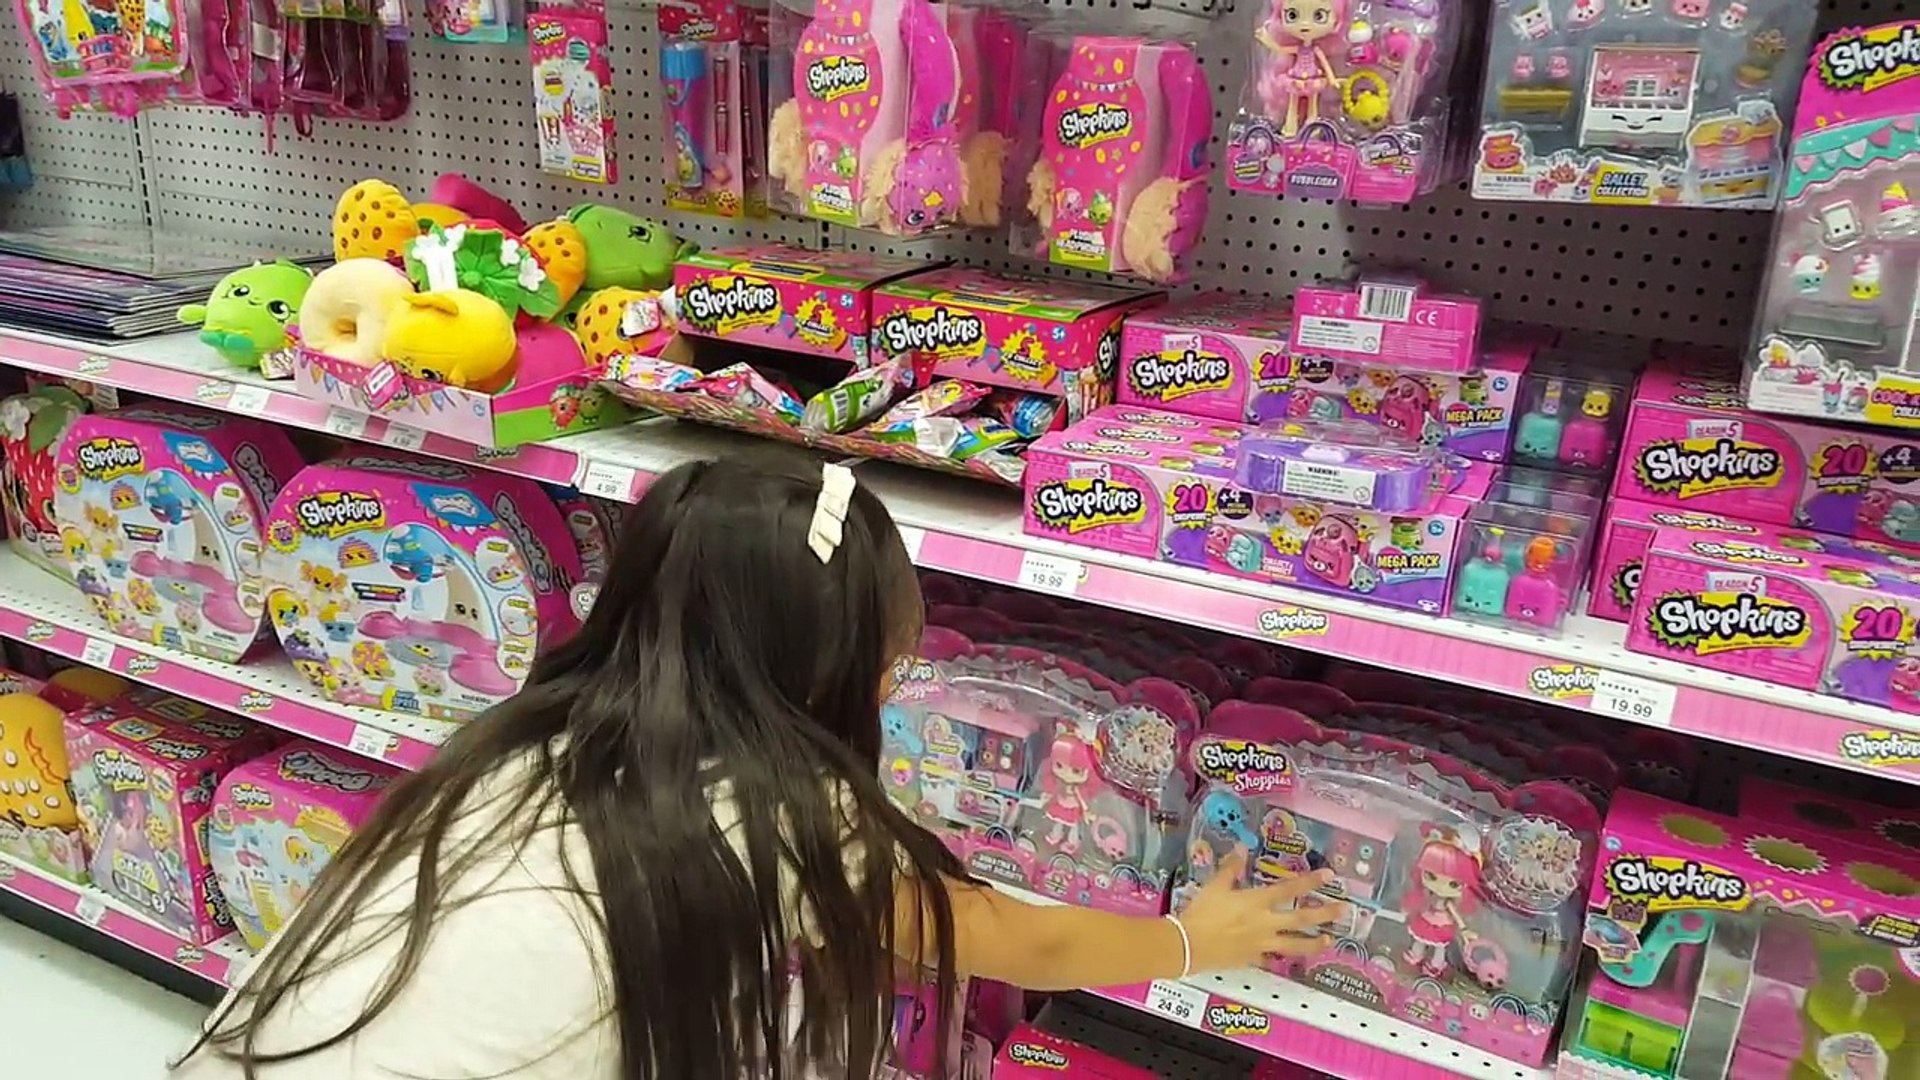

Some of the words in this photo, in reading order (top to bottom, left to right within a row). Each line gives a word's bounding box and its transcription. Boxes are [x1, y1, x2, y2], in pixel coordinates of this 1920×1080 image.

[1827, 28, 1920, 80] Shopk
[808, 56, 867, 95] Shopkins
[1060, 102, 1129, 140] Shopkins
[1596, 186, 1649, 197] COLLECTION
[1602, 172, 1648, 187] BALLET
[687, 277, 776, 319] Shopkins
[885, 309, 980, 351] Shopkins
[1134, 351, 1228, 388] Shopkins
[1259, 353, 1291, 379] 20
[1446, 410, 1474, 422] MEGA
[1476, 409, 1504, 422] PACK
[1728, 422, 1740, 438] 5
[80, 440, 142, 470] Shopkins
[1645, 439, 1775, 481] Shopkins
[1819, 444, 1867, 477] 20
[299, 494, 380, 525] Shopkins
[1039, 479, 1140, 518] Shopkins
[1173, 483, 1208, 513] 20
[1377, 554, 1408, 568] MEGA
[1410, 554, 1440, 568] PACK
[1032, 573, 1063, 588] 19.99
[1748, 576, 1762, 593] 5
[1259, 608, 1327, 631] Shopkins
[1659, 595, 1804, 637] Shopkins
[1850, 606, 1903, 640] 20
[1533, 667, 1599, 692] Shopkin
[1609, 697, 1654, 719] 19.99
[1200, 743, 1286, 772] Shopkins
[1234, 772, 1292, 792] Shoppies
[1613, 860, 1745, 899] Shopkins
[1157, 997, 1190, 1019] 24.99
[1208, 1007, 1268, 1029] Shopkins
[1012, 1043, 1066, 1066] Shopkins
